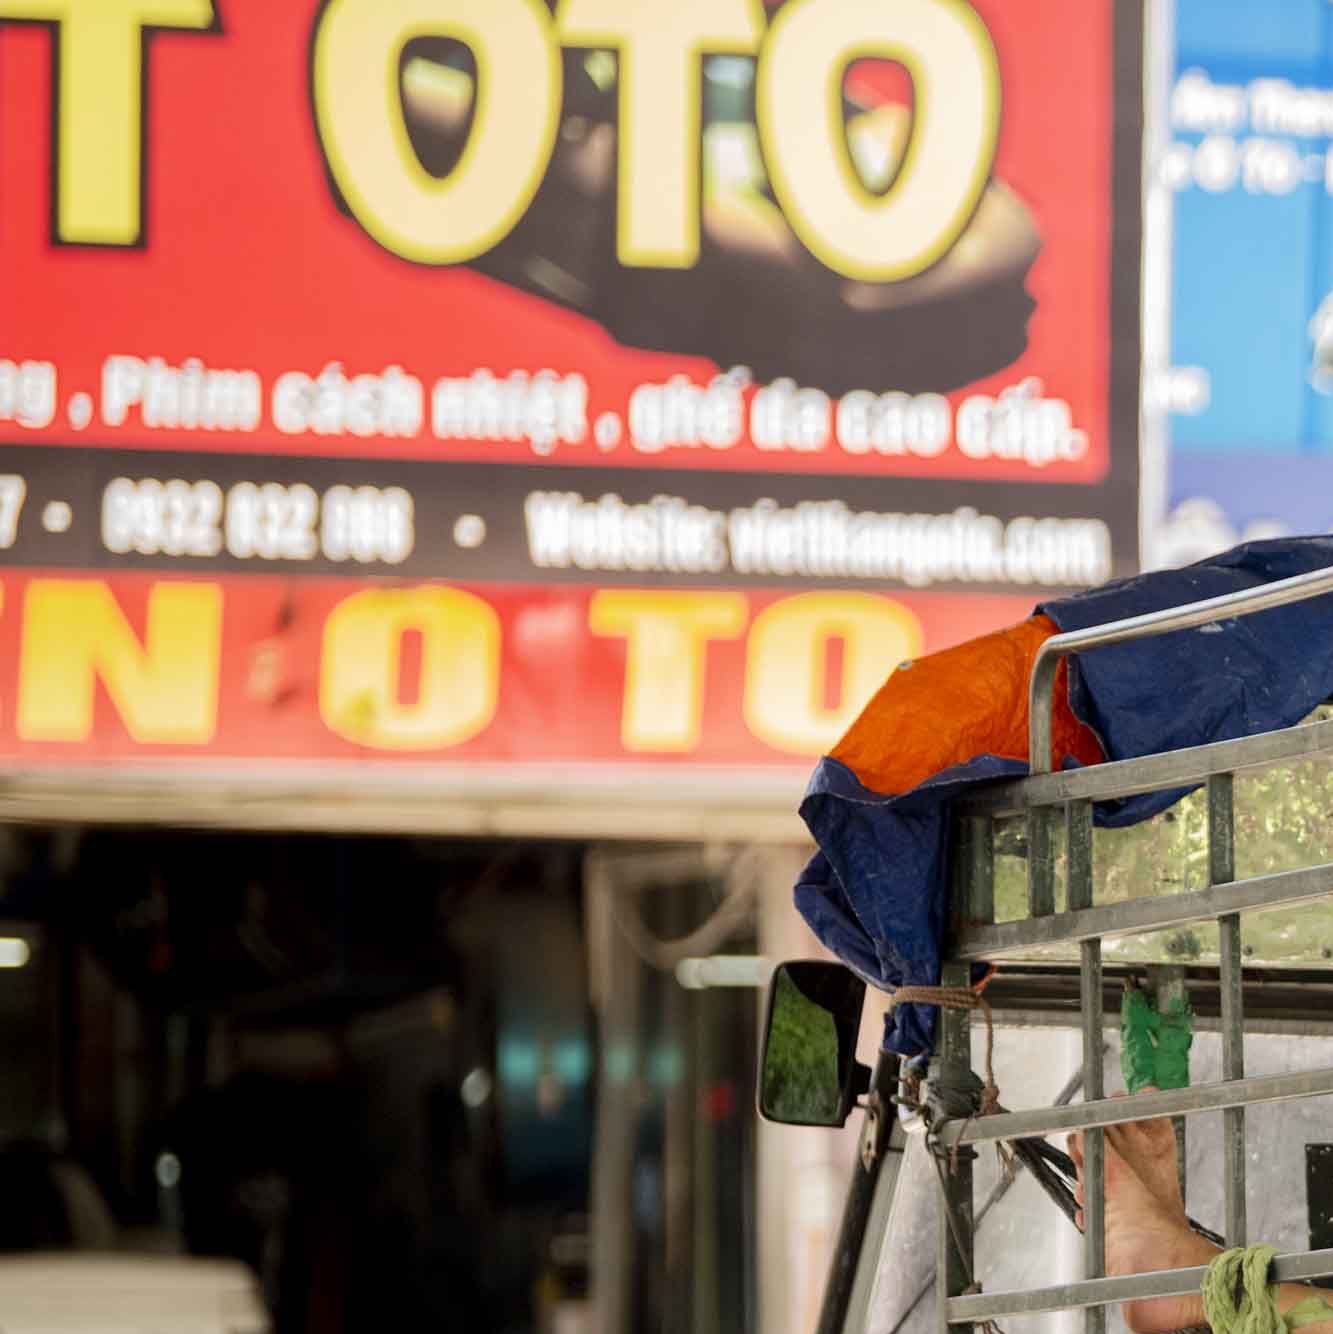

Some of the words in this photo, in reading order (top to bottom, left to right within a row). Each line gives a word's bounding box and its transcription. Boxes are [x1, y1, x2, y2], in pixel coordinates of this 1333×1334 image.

[102, 353, 261, 431] Phim
[273, 361, 424, 437] cách
[836, 389, 951, 457] cao
